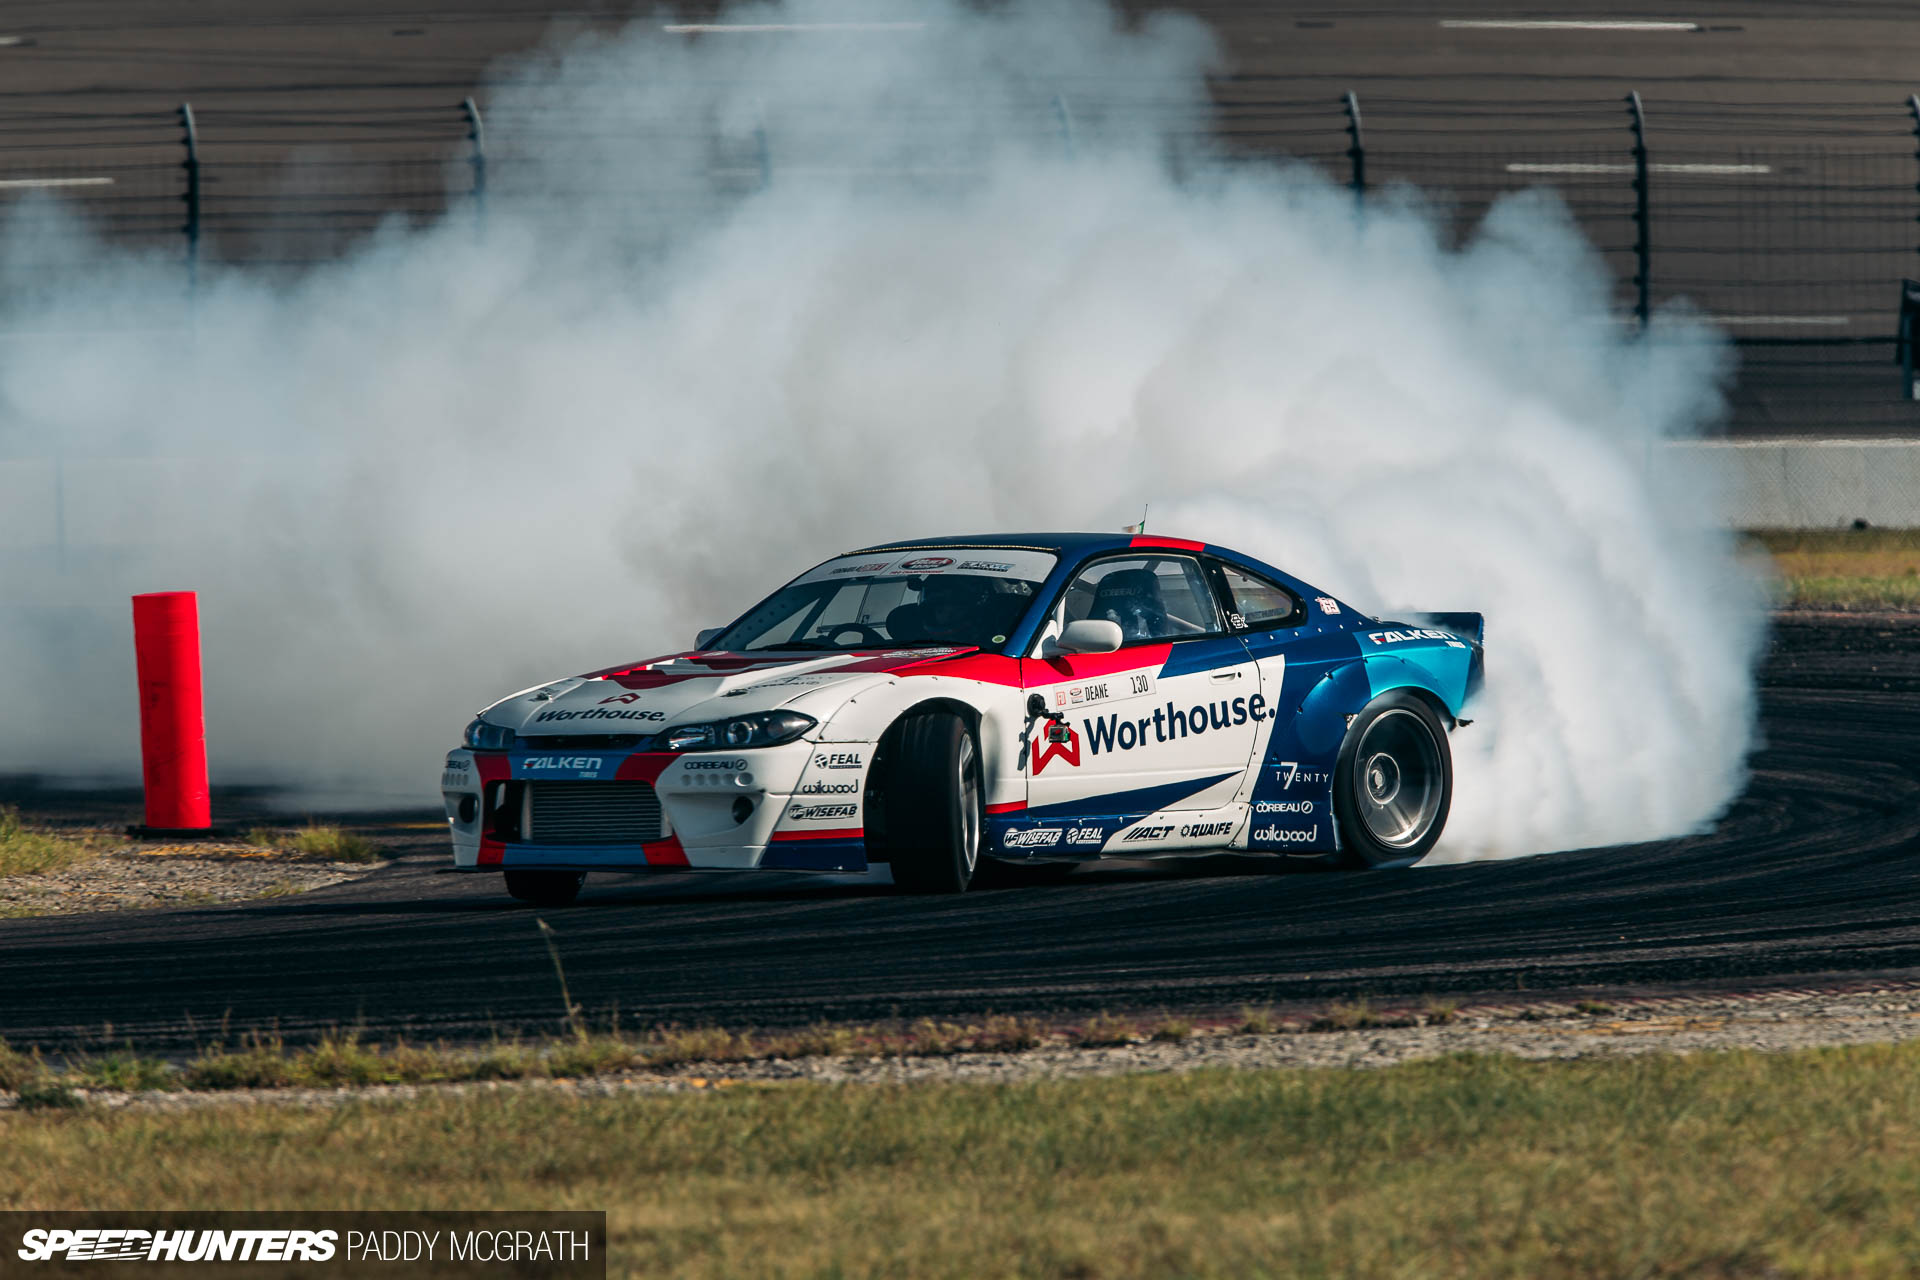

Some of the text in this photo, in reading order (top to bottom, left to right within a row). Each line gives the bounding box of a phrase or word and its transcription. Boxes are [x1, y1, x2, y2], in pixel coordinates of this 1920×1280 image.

[1368, 629, 1457, 645] FALKEN
[1130, 675, 1149, 694] 130
[1085, 684, 1109, 701] DEANE
[536, 708, 666, 722] Worthouse.
[1084, 693, 1276, 755] Worthouse.
[523, 757, 602, 769] FALKEN
[684, 760, 735, 770] CORBEAU
[830, 754, 862, 764] FEAL
[1276, 771, 1329, 783] TWENTY
[1280, 761, 1298, 790] 7
[802, 779, 859, 794] wilwood
[805, 806, 857, 818] WISEFAB
[1256, 802, 1300, 813] CORBEAU
[1078, 828, 1103, 839] FEAL
[1189, 821, 1233, 838] QUAIFE
[1254, 823, 1318, 842] wilwood
[1016, 832, 1062, 845] WISEFAB
